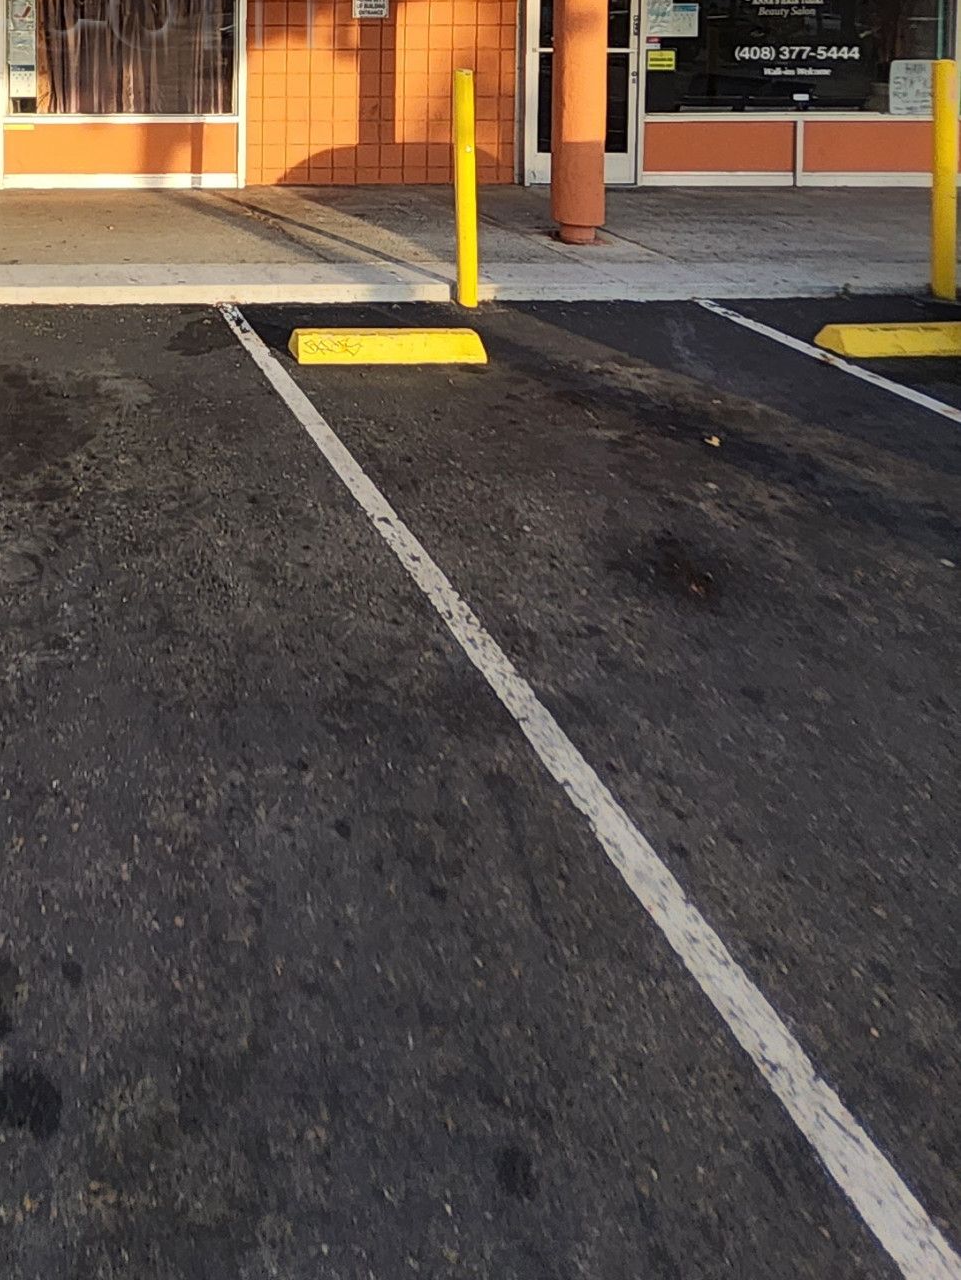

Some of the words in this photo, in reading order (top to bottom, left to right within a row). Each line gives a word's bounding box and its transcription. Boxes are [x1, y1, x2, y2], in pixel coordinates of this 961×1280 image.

[758, 7, 789, 18] Beauty
[790, 6, 816, 16] Salon
[734, 46, 776, 61] (408)
[779, 46, 860, 60] 377-5444
[796, 66, 832, 76] Welcome
